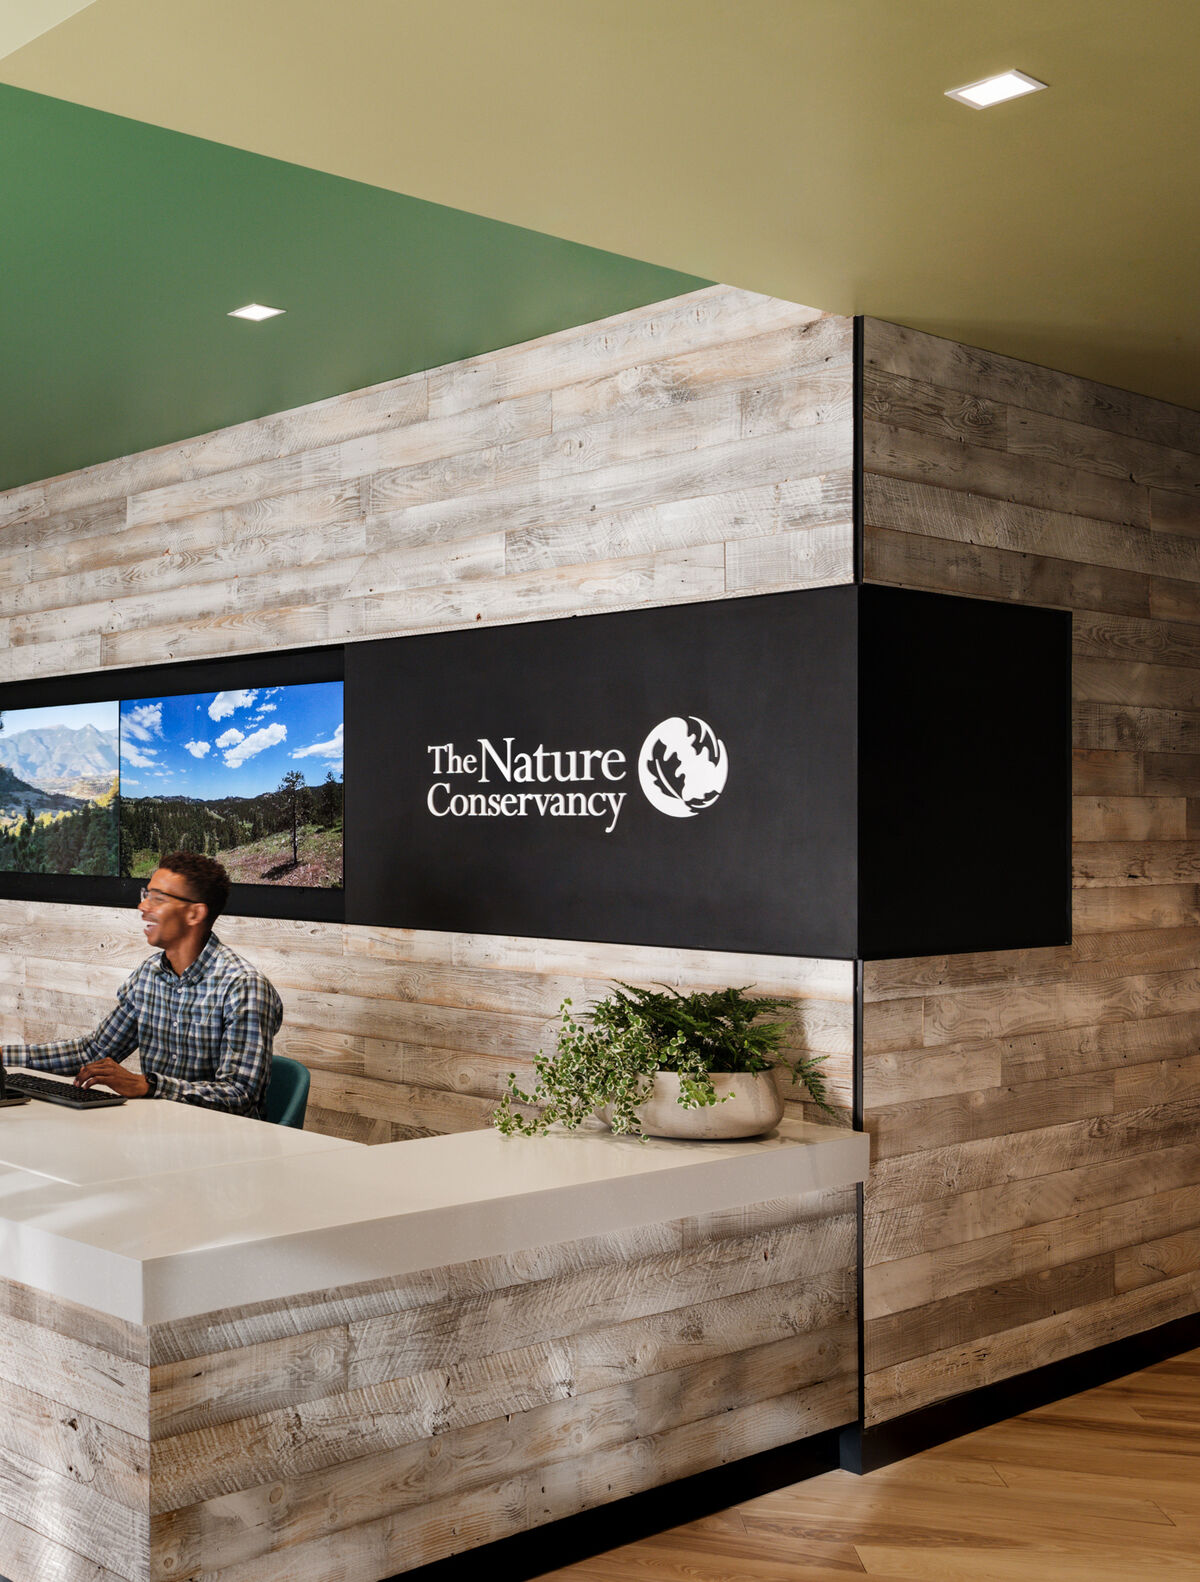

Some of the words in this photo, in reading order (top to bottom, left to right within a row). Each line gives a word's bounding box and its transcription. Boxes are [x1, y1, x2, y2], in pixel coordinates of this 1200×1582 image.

[427, 743, 477, 774] The
[477, 737, 626, 783] Nature
[427, 783, 627, 833] Conservancy
